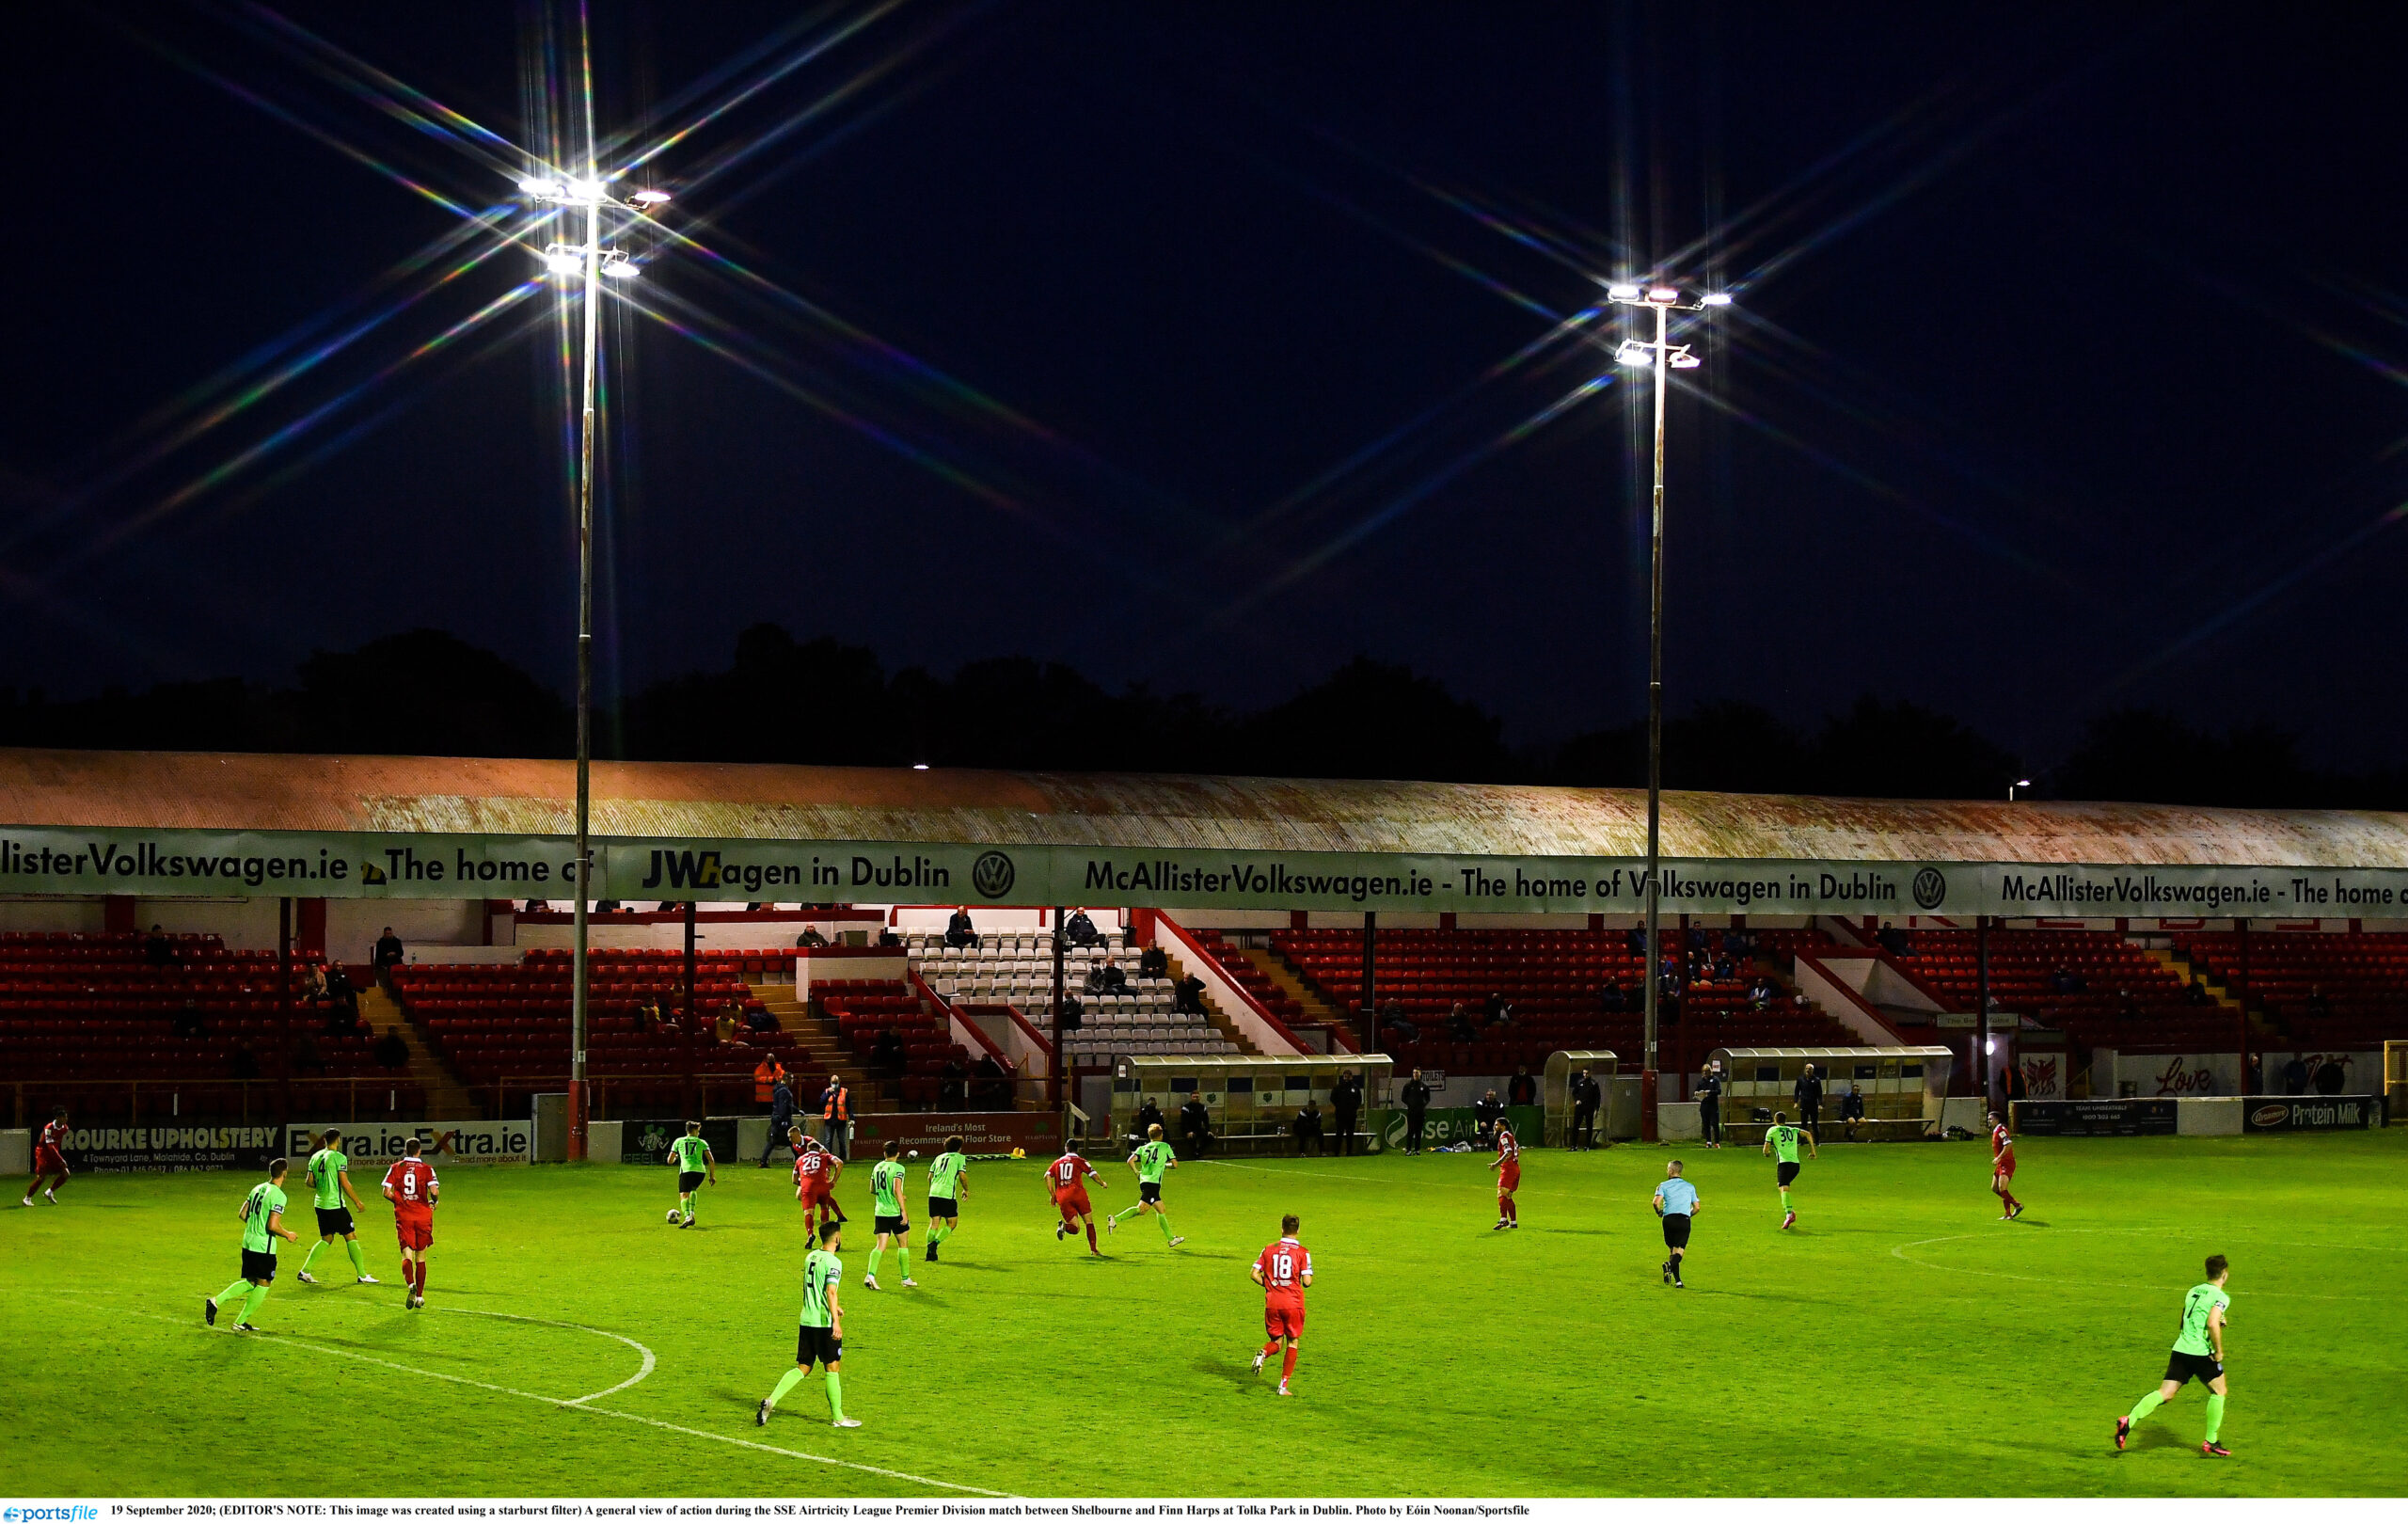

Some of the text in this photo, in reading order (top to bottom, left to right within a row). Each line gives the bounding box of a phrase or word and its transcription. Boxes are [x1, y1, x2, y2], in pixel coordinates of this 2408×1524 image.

[386, 848, 444, 881] The
[457, 849, 549, 882] home
[813, 857, 839, 885] in
[851, 856, 950, 887] Dublin
[1085, 861, 1433, 902] McAllisterVolkswagen.ie
[1461, 869, 1506, 897] The
[1515, 869, 1587, 898] home
[1595, 869, 1621, 897] of
[1628, 870, 1781, 906] Vlkswagen
[1789, 874, 1810, 900] in
[1820, 873, 1896, 900] Dublin
[2001, 875, 2271, 910] McAllisterVolkswagen.ie
[2291, 877, 2328, 903] The
[2336, 878, 2393, 903] home
[2156, 1056, 2211, 1098] Love
[2292, 1103, 2335, 1126] Protein
[2337, 1102, 2361, 1125] Milk
[61, 1127, 278, 1151] ROURKE UPHOLSTERY
[926, 1123, 986, 1133] Ireland's Most
[965, 1135, 987, 1143] Floor
[989, 1134, 1011, 1142] Store
[1780, 1128, 1794, 1143] 30
[210, 1151, 235, 1162] Dublin
[476, 1155, 497, 1164] more
[498, 1154, 520, 1163] about
[685, 1142, 697, 1156] 17
[318, 1158, 326, 1176] 4
[802, 1156, 821, 1171] 26
[1059, 1163, 1074, 1180] 10
[404, 1173, 416, 1195] 9
[876, 1170, 887, 1190] 18
[250, 1192, 263, 1215] 16
[807, 1262, 816, 1288] 5
[1273, 1254, 1292, 1279] 18
[2191, 1294, 2200, 1319] 7
